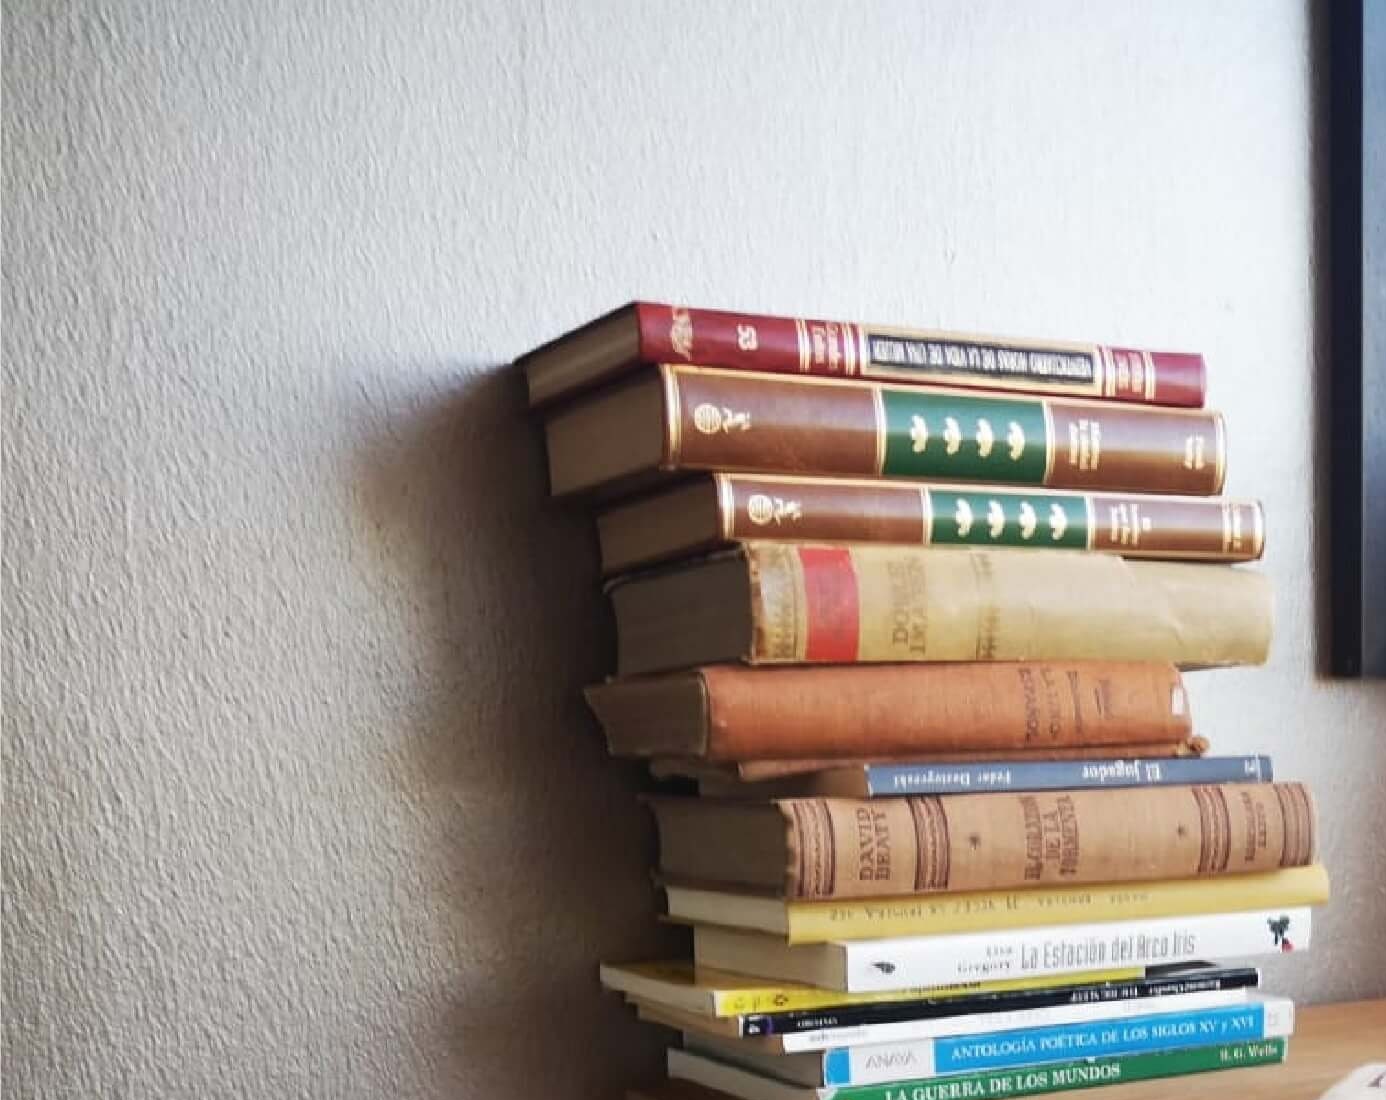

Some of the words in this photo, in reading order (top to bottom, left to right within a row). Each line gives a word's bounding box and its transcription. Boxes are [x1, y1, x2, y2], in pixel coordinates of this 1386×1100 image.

[857, 807, 873, 881] DAVID
[1021, 943, 1039, 969] La
[1112, 934, 1133, 960] del
[1136, 932, 1169, 960] Arco
[1172, 928, 1196, 955] Iris
[951, 1036, 1036, 1060] ANTOLOGÍA
[1101, 1029, 1118, 1044] DE
[1123, 1026, 1149, 1042] LOS
[1151, 1022, 1196, 1039] SIGLOS
[1199, 1019, 1217, 1035] XV
[1231, 1015, 1254, 1031] XVI
[865, 1049, 918, 1070] ANAYA
[990, 1077, 1013, 1094] DE
[1015, 1072, 1048, 1090] LOS
[1052, 1063, 1121, 1086] MUNDOS
